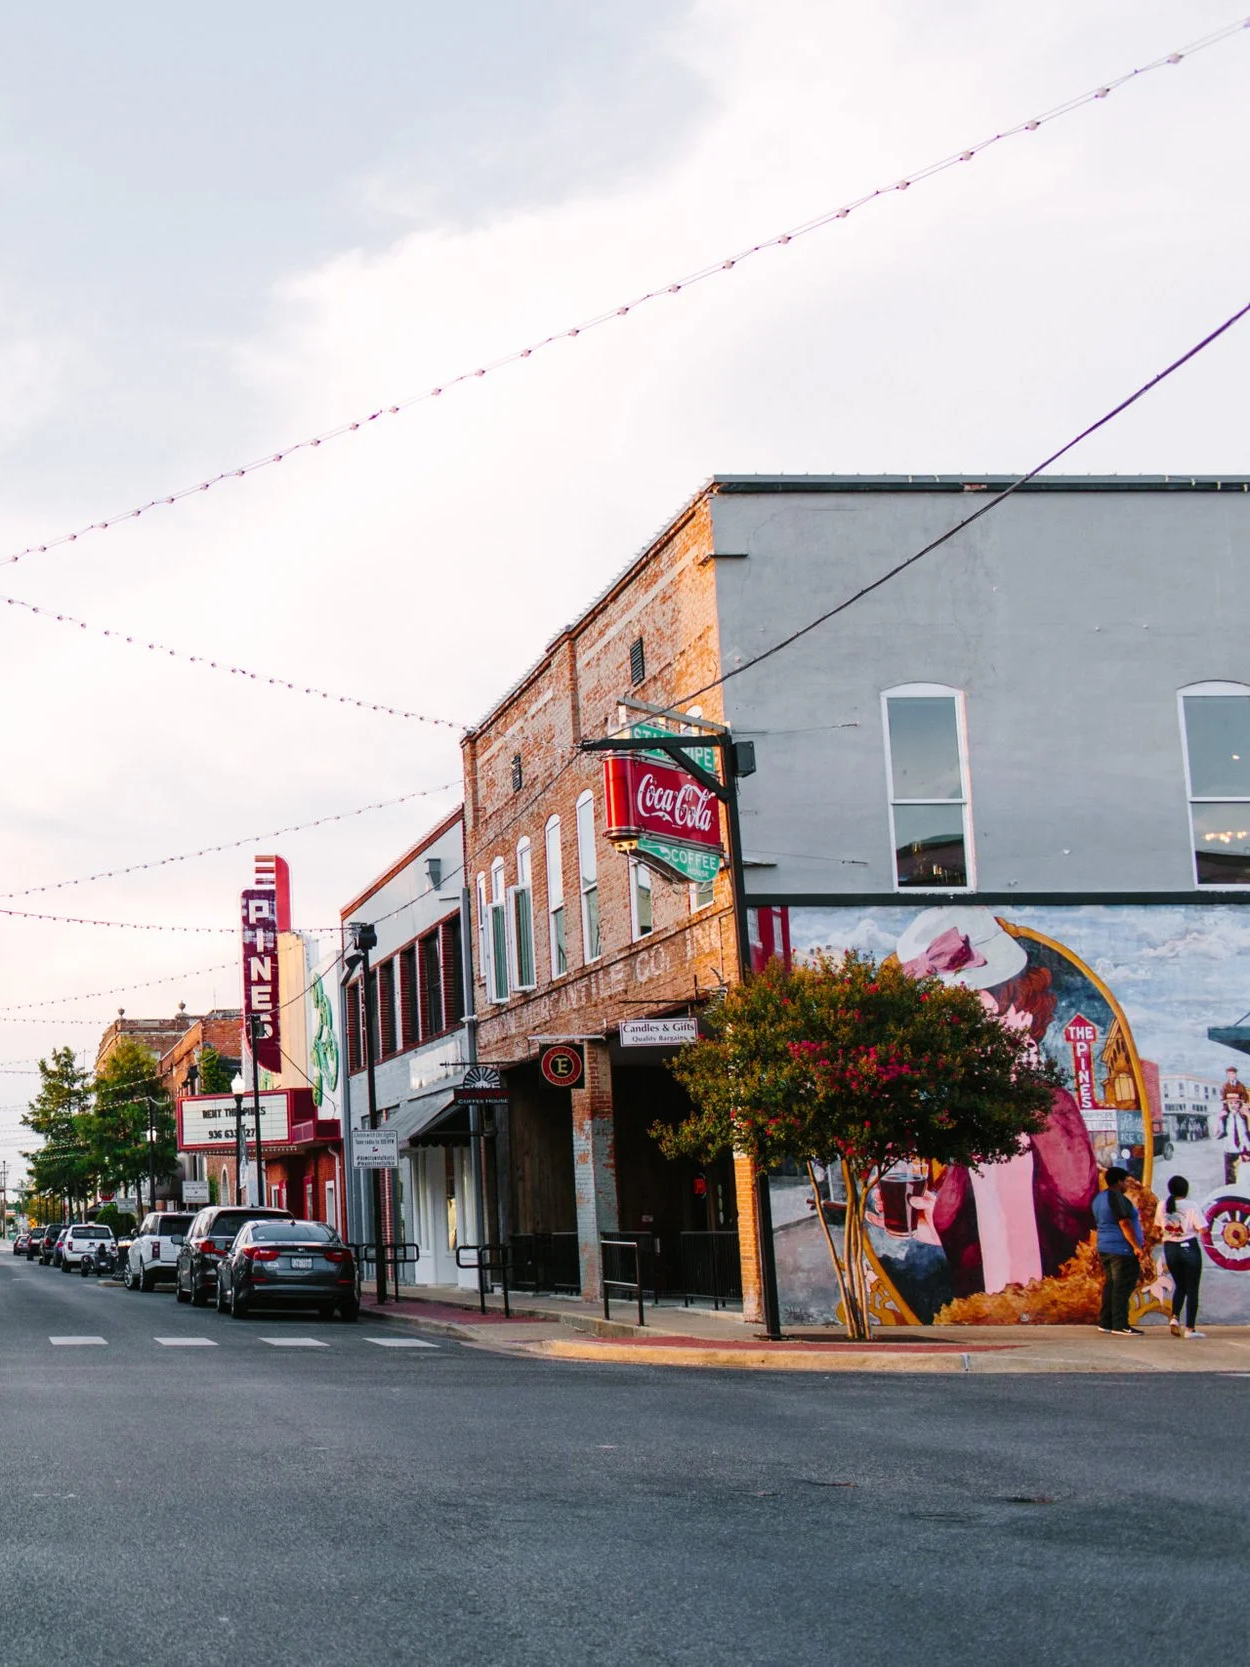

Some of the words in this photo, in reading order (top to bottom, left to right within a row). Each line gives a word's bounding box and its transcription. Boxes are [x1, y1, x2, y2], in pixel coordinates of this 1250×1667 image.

[670, 848, 717, 870] COFFEE
[622, 1023, 660, 1033] Candles
[662, 1023, 670, 1032] &
[672, 1022, 695, 1032] Gifts
[1067, 1026, 1094, 1040] THE
[632, 1034, 656, 1043] Quality
[554, 1057, 569, 1074] E
[1075, 1041, 1092, 1109] PINES
[202, 1109, 222, 1119] RENT
[208, 1129, 222, 1139] 936
